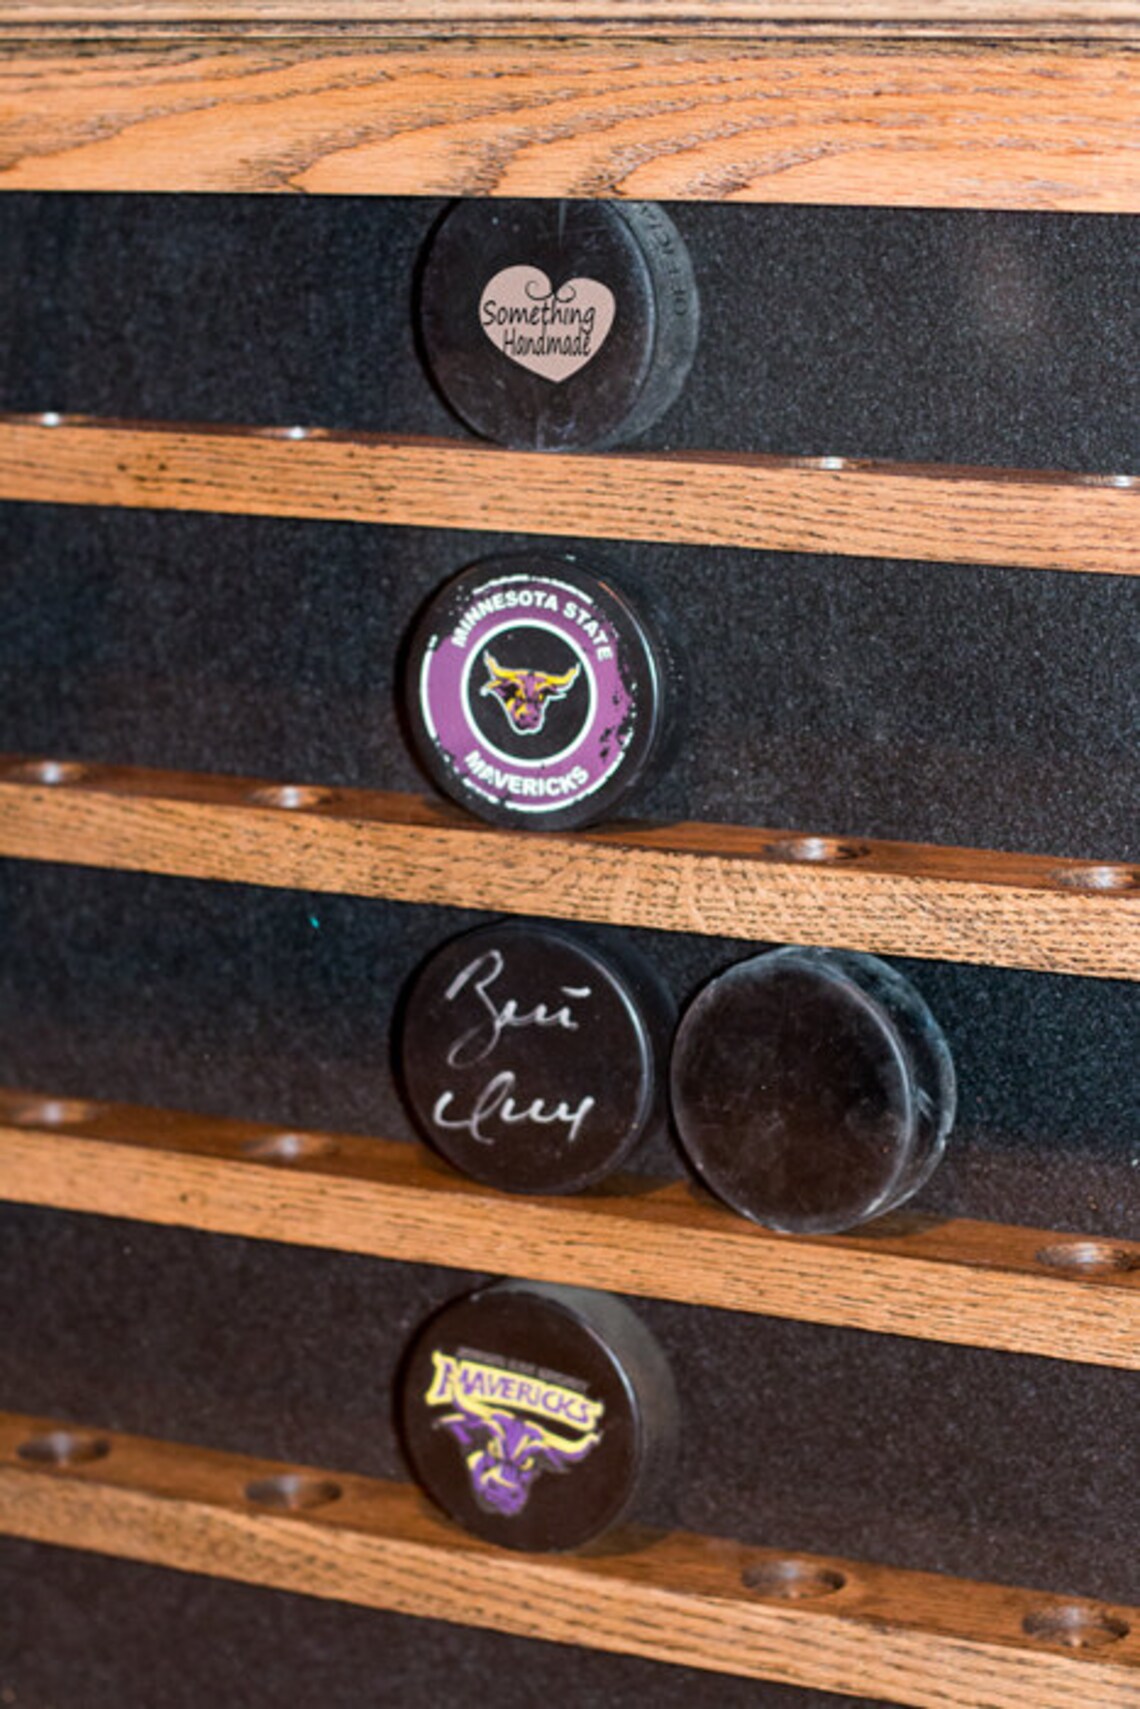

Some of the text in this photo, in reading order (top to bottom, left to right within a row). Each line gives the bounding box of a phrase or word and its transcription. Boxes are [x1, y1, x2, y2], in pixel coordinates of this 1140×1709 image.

[451, 590, 613, 662] MINNESOTA STATE
[464, 750, 589, 796] MAVERICKS
[435, 1361, 591, 1424] MAVERICKS
